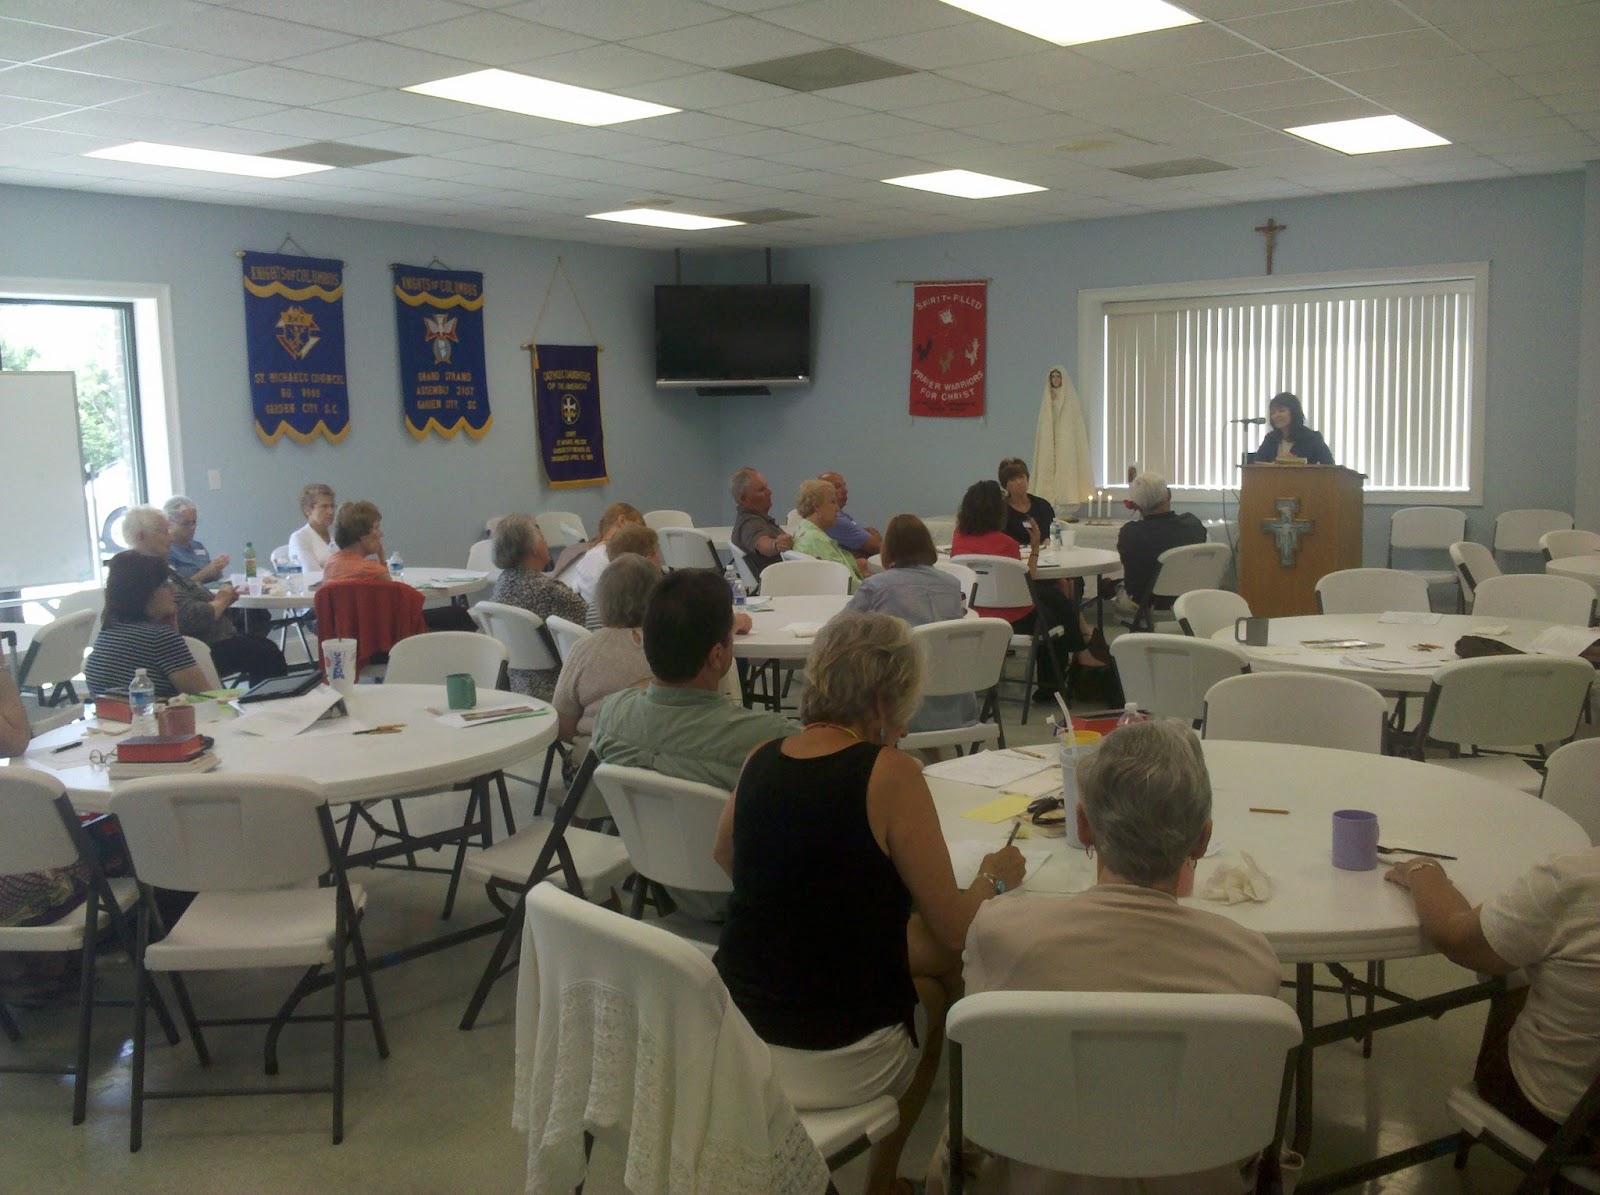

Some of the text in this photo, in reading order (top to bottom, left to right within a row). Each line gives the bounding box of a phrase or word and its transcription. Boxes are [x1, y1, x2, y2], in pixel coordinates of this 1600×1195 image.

[913, 369, 984, 391] PRAYER WARRIORS
[920, 387, 975, 401] FOR CHRIST
[333, 651, 345, 679] SONIC
